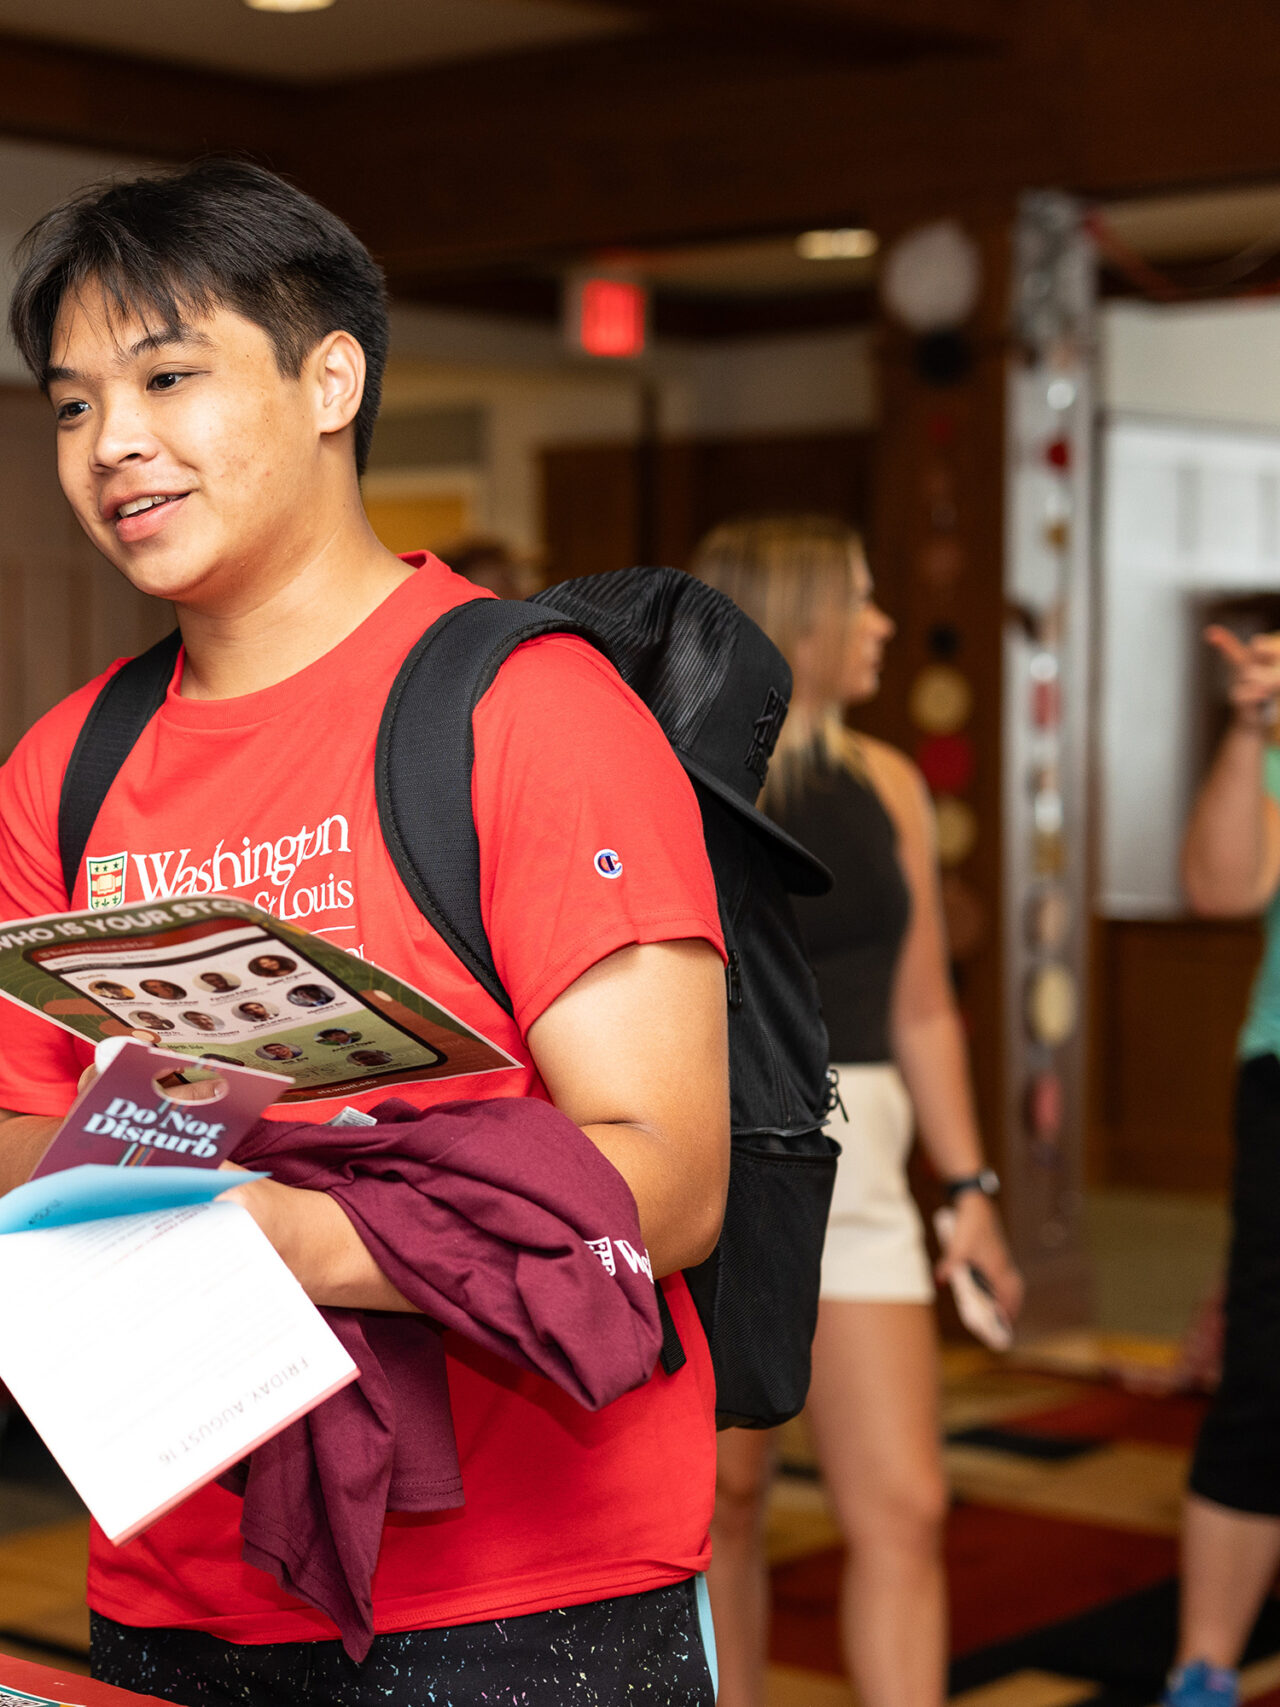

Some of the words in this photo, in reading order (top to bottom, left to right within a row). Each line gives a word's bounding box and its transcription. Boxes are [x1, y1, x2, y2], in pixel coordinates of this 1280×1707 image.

[131, 814, 352, 905] Washington
[279, 873, 355, 921] Louis
[55, 920, 87, 938] IS
[84, 907, 176, 933] YOUR
[82, 1112, 218, 1159] Disturb
[104, 1097, 158, 1125] Do
[158, 1110, 226, 1140] Not
[179, 1400, 245, 1453] AUGUST
[158, 1449, 177, 1466] 16
